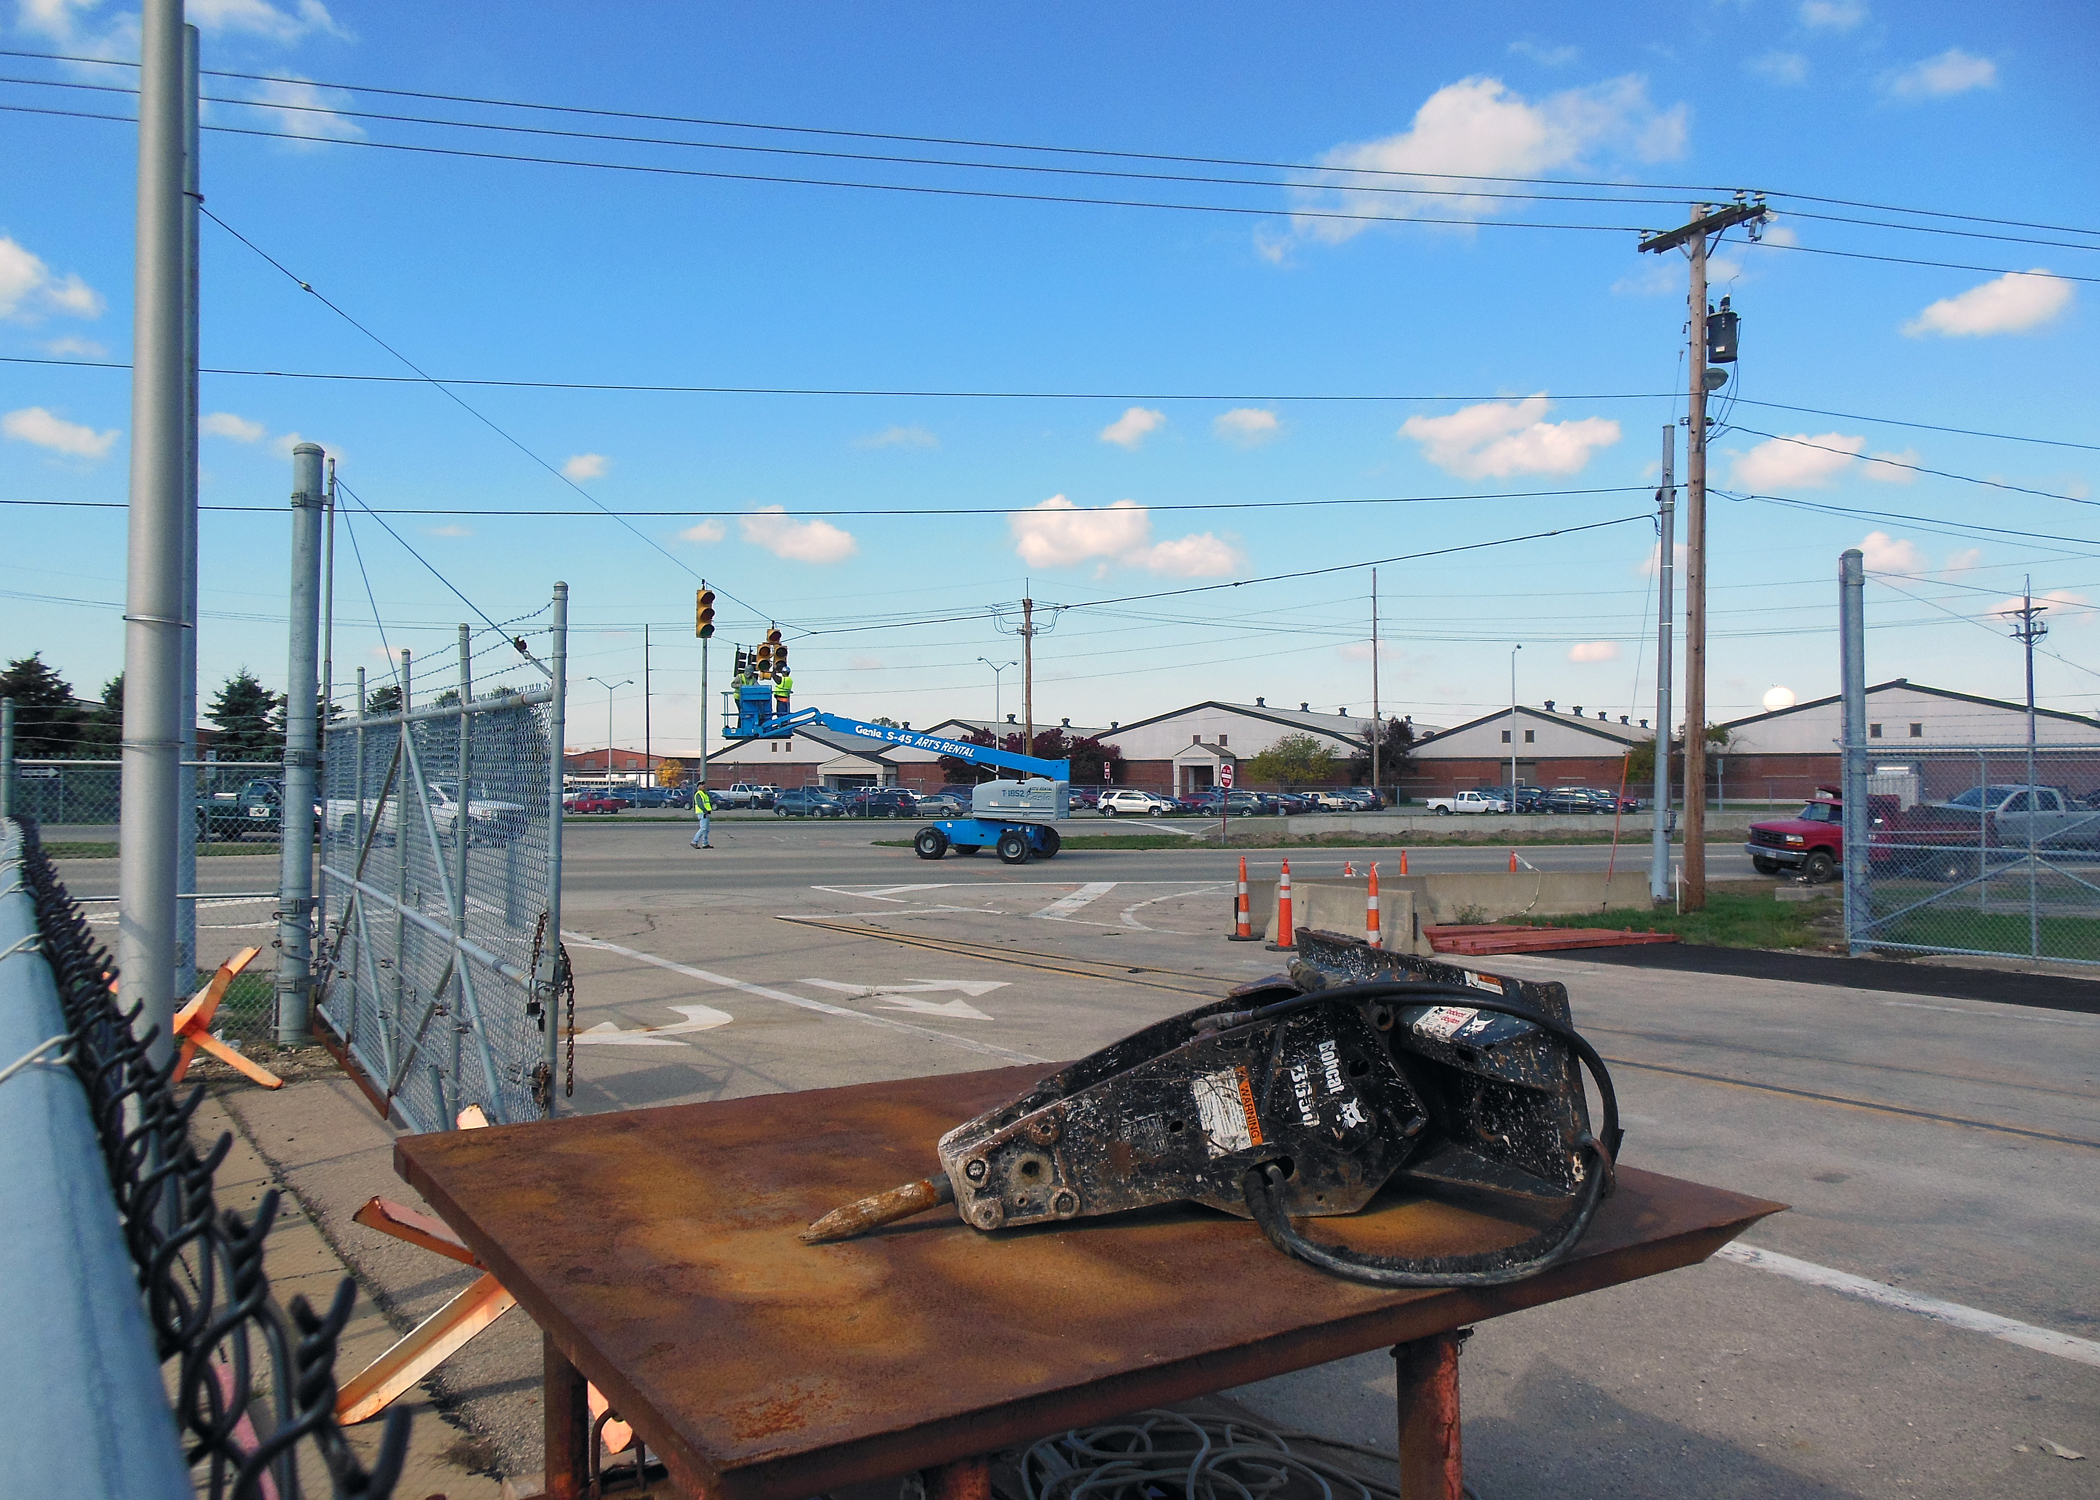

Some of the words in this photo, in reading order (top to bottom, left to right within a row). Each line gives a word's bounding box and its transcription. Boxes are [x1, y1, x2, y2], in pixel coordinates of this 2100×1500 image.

[855, 725, 883, 738] Genie
[886, 731, 912, 744] S-45
[914, 736, 941, 750] ART'S
[940, 741, 975, 757] RENTAL
[1240, 1085, 1260, 1139] WARNING
